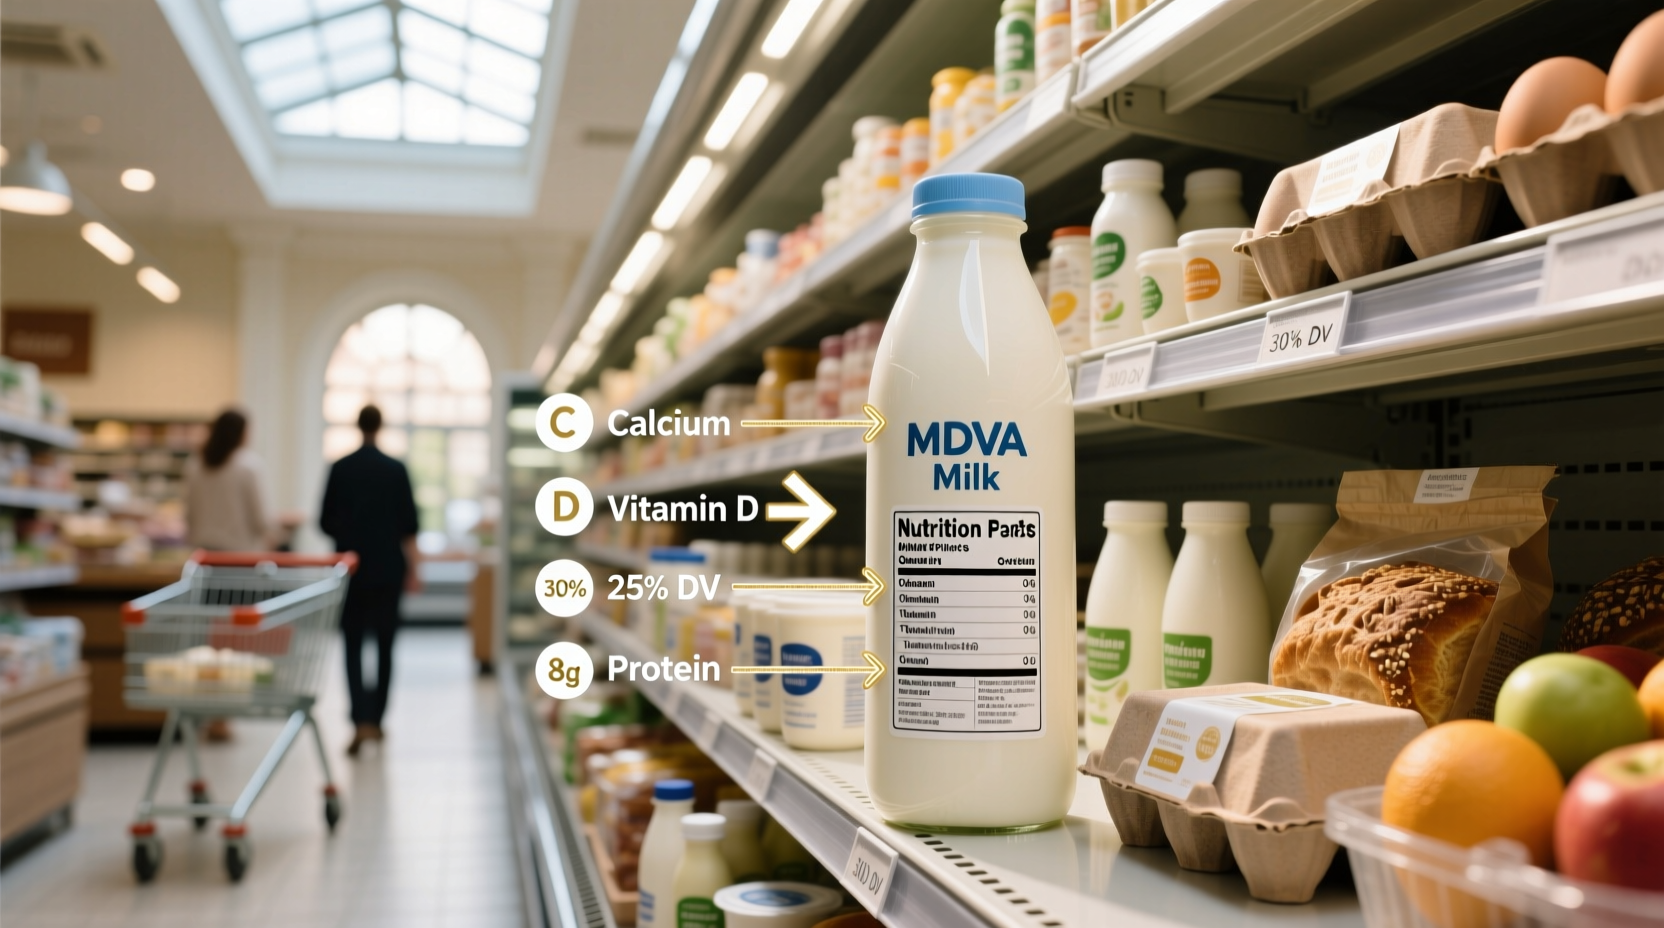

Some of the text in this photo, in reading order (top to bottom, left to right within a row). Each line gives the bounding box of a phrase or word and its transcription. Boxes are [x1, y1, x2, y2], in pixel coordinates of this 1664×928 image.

[1308, 322, 1334, 346] DV
[907, 421, 1028, 457] MDVA
[933, 462, 1001, 491] Milk
[898, 517, 982, 538] Nutrition
